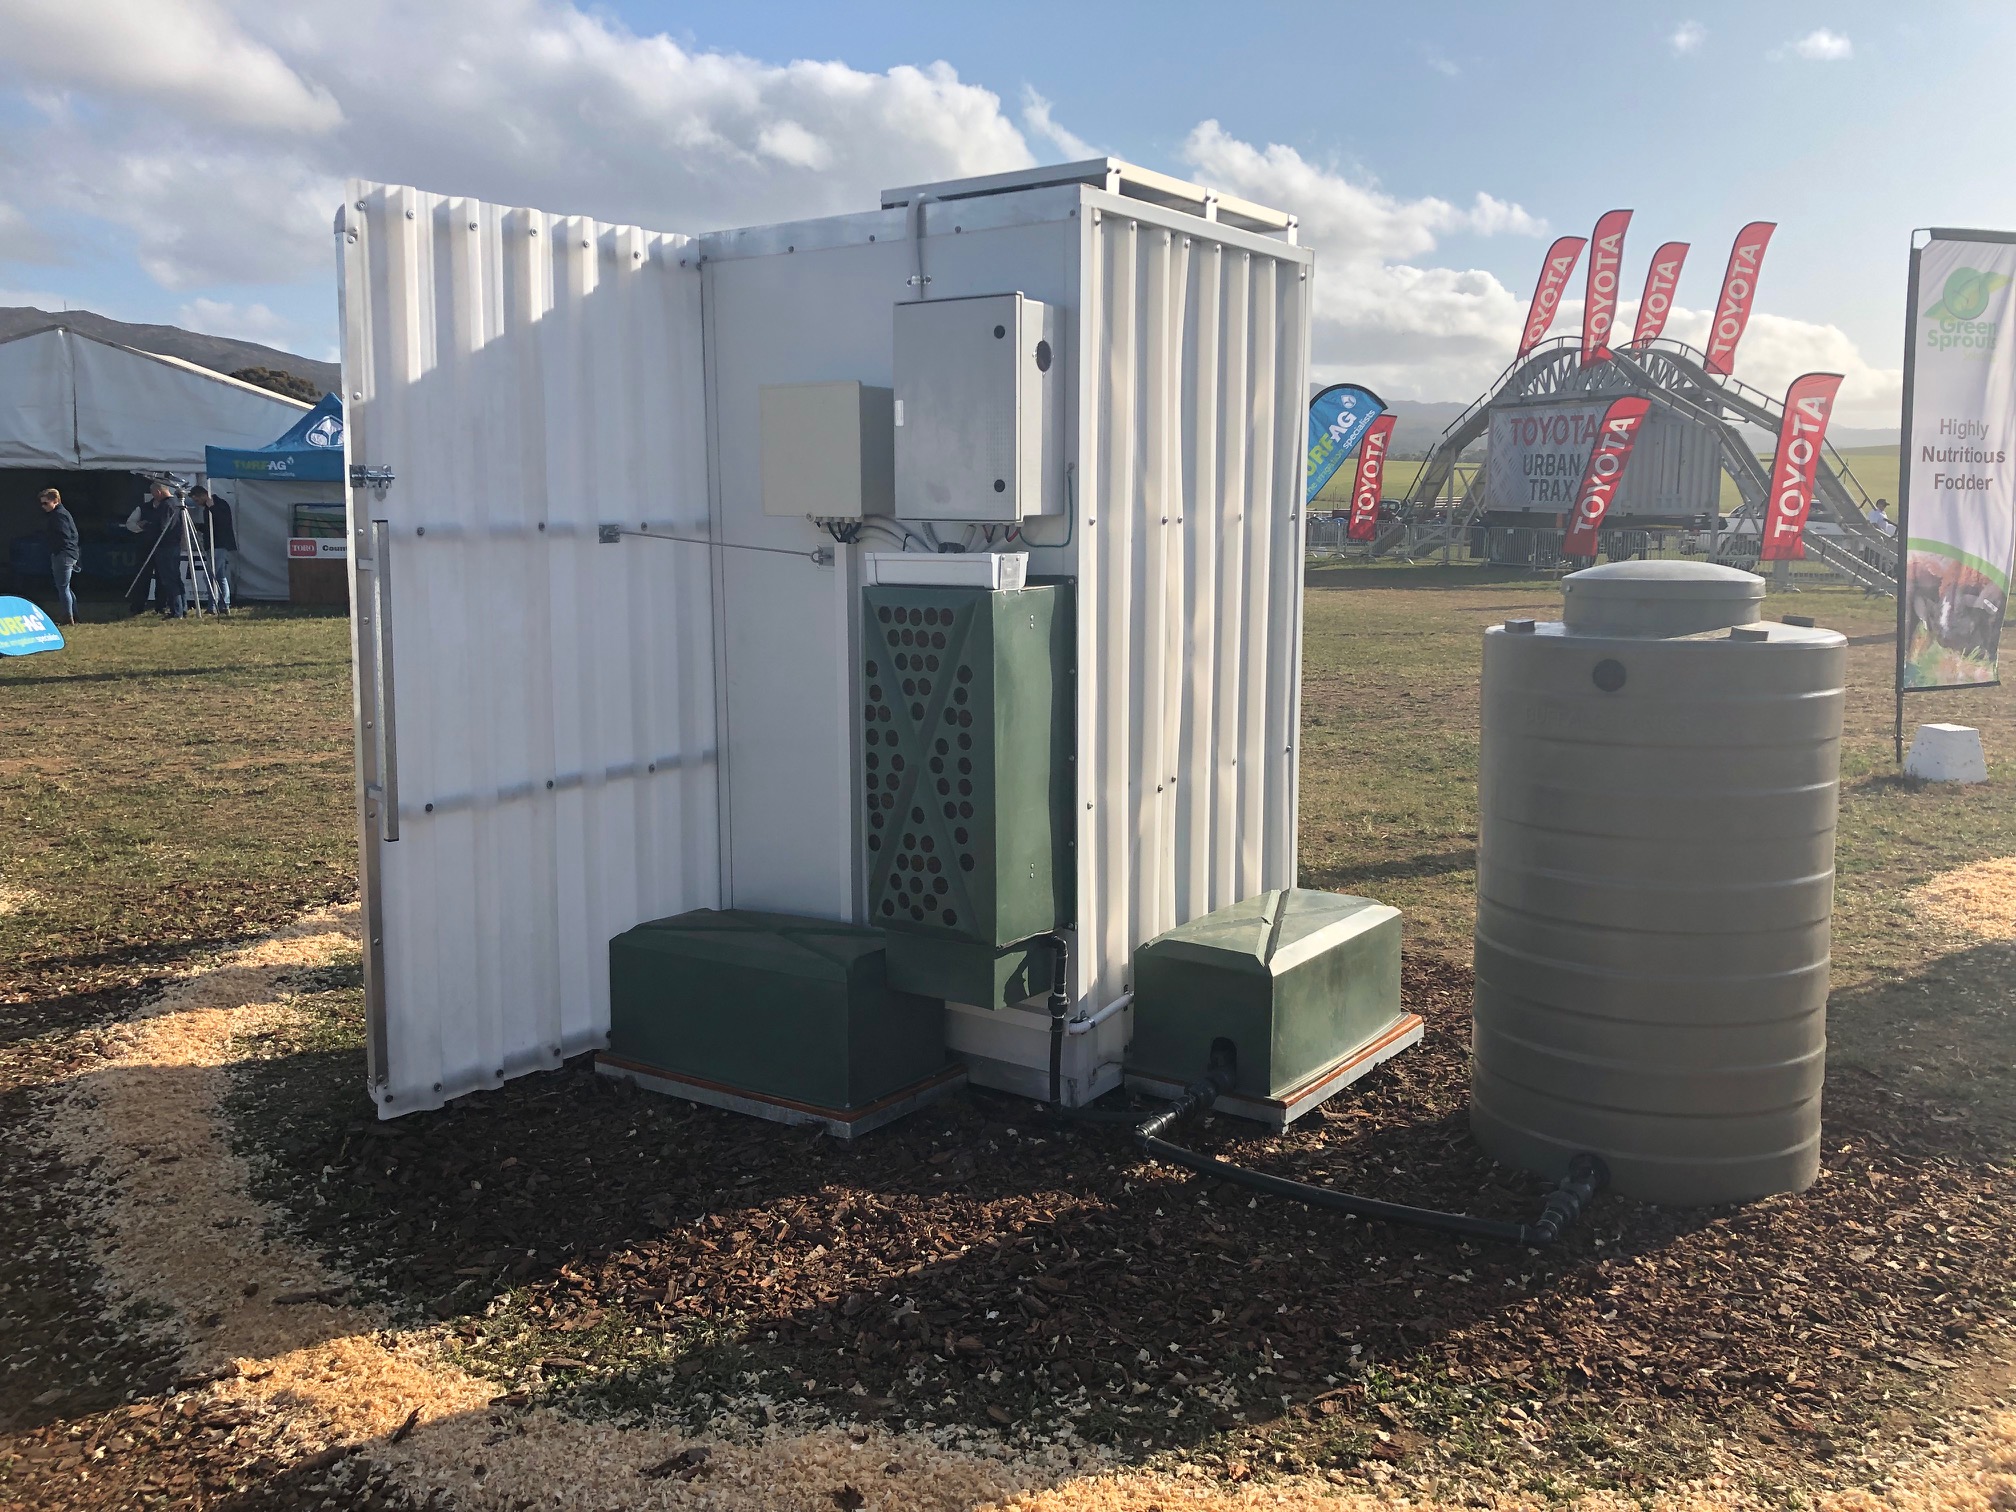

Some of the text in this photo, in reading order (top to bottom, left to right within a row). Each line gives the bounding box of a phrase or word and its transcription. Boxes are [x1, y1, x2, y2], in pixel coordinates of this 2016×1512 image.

[1589, 232, 1622, 352] TOYOTA
[1711, 243, 1761, 355] TOYOTA
[1940, 317, 1997, 334] Green
[1342, 409, 1376, 450] specialists
[1510, 413, 1599, 446] TOYOTA
[1940, 418, 1989, 440] Highly
[1522, 453, 1581, 477] URBAN
[1774, 396, 1826, 537] TOYOTA
[1922, 446, 2006, 463] Nutritious
[1355, 431, 1387, 524] TOYOTA
[1529, 478, 1574, 501] TRAX
[1574, 417, 1635, 534] TOYOTA
[1934, 473, 1994, 490] Fodder
[291, 544, 315, 552] TORO
